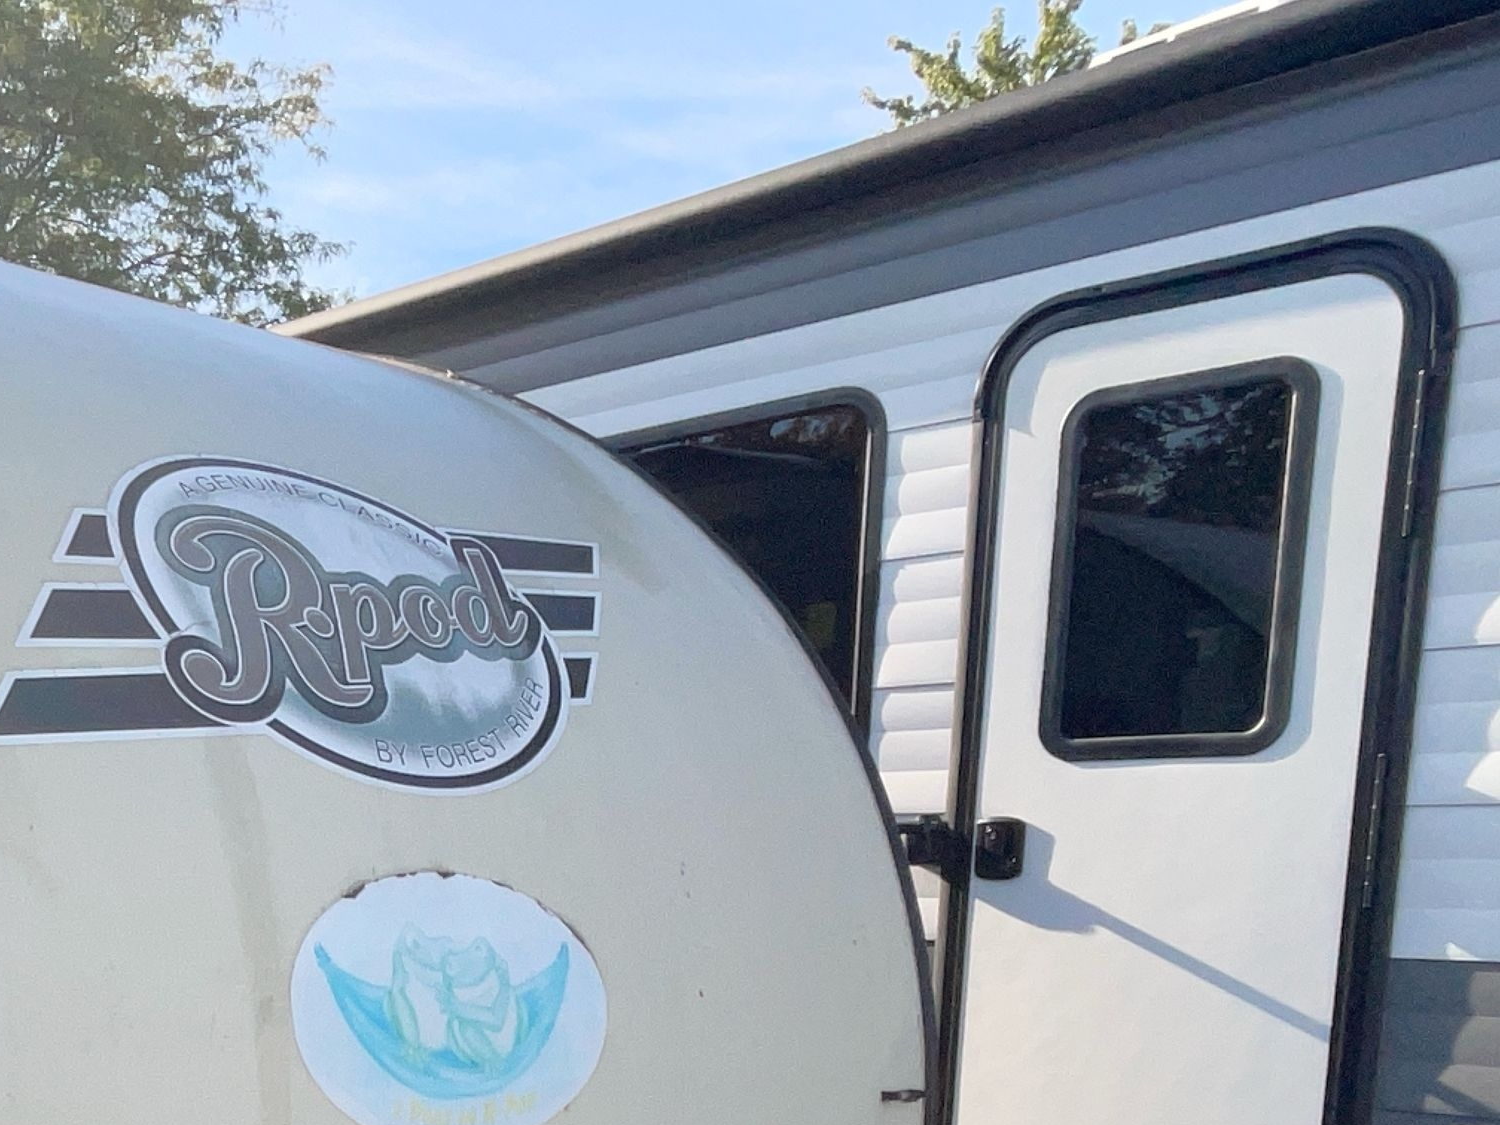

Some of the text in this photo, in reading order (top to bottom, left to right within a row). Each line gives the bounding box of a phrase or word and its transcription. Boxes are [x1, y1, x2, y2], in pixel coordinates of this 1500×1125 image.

[178, 473, 442, 556] A GENUINE CLASSIC
[375, 676, 544, 769] BY FOREST RIVER
